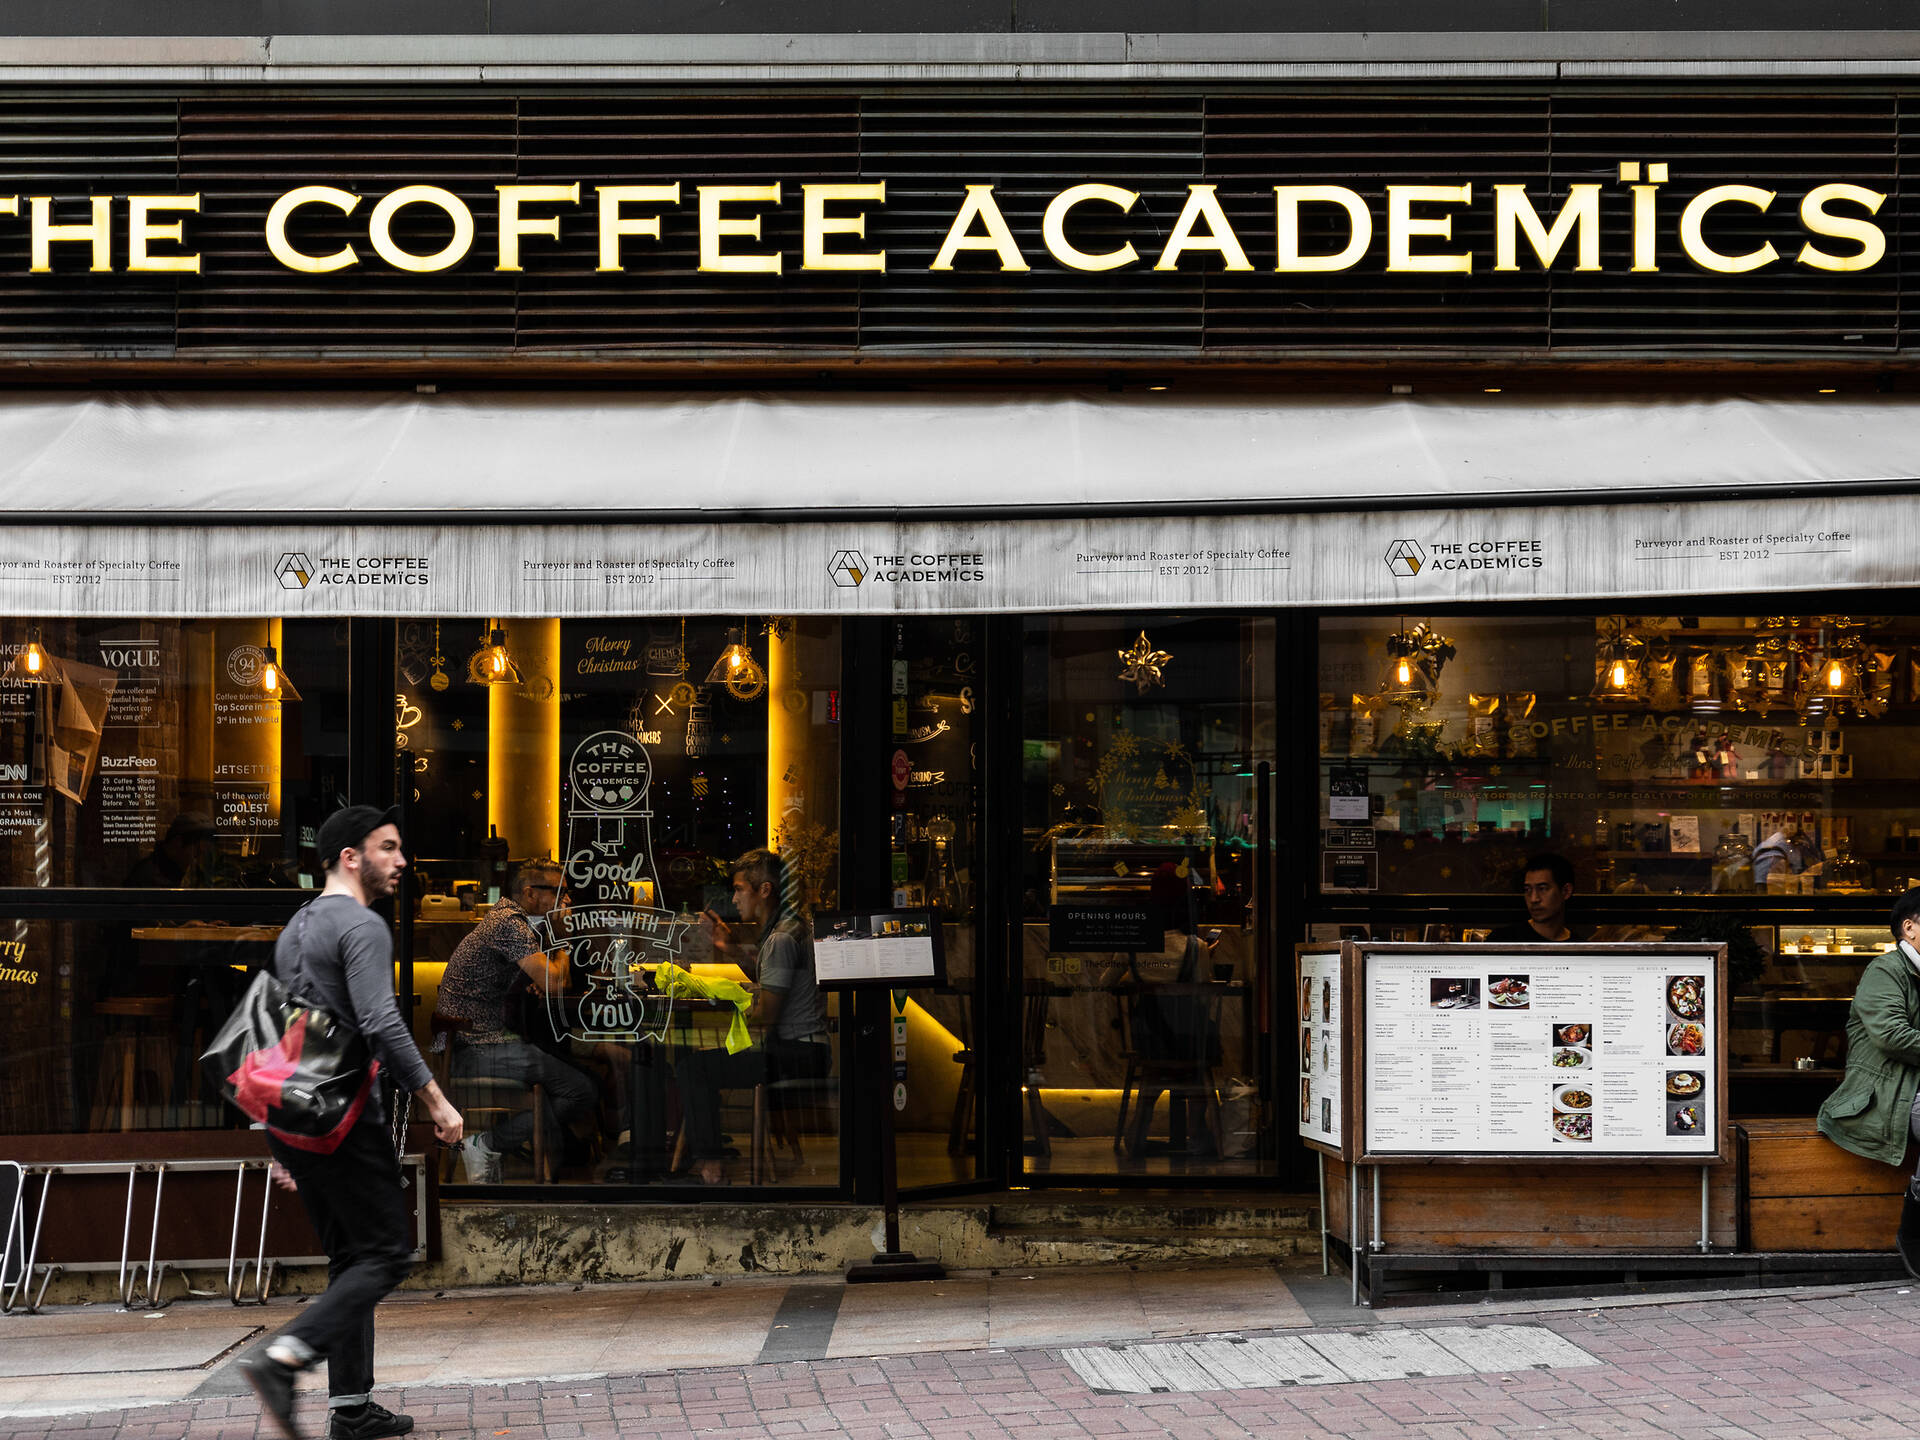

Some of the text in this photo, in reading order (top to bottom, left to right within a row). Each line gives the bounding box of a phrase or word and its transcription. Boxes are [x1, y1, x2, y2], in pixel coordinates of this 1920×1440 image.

[0, 193, 201, 273] HE
[266, 181, 886, 274] COFFEE
[1635, 532, 1851, 549] Purveyor and Roaster of Specialty Coffee
[1430, 541, 1542, 554] THE COFFEE
[873, 554, 984, 566] THE COFFEE
[1076, 548, 1291, 563] Purveyor and Roaster of Specialty Coffee
[1719, 550, 1770, 560] EST 2012
[0, 559, 181, 572] yor and Roaster of Specialty Coffee
[319, 557, 429, 569] THE COFFEE
[523, 558, 735, 572] Purveyor and Roaster of Specialty Coffee
[1159, 565, 1209, 576] EST 2012
[53, 575, 101, 584] EST 2012
[605, 574, 655, 584] EST 2012
[585, 635, 632, 656] Merry
[100, 650, 160, 667] VOGUE
[239, 657, 256, 671] 94
[577, 656, 638, 674] Christmas
[4, 661, 16, 671] IN
[0, 678, 43, 688] CIALTY
[120, 705, 140, 713] perfect
[213, 703, 228, 712] Top
[230, 703, 255, 711] Score
[255, 703, 262, 711] in
[216, 716, 279, 724] 3rd in the World
[1508, 713, 1631, 743] COFFEE
[586, 742, 634, 759] THE
[576, 763, 646, 774] COFFEE
[113, 777, 133, 785] Coffee
[136, 777, 156, 785] Shops
[7, 792, 42, 800] IN A CONE
[222, 791, 230, 799] of
[232, 791, 246, 799] the
[223, 803, 269, 813] COOLEST
[215, 816, 279, 829] Coffee Shops
[568, 850, 652, 888] Good
[598, 885, 631, 900] DAY
[563, 910, 660, 933] STARTS WITH
[1067, 912, 1147, 921] OPENING HOURS
[573, 939, 649, 974] Coffee
[0, 963, 39, 984] mas
[606, 985, 618, 1001] &
[591, 1002, 634, 1028] YOU
